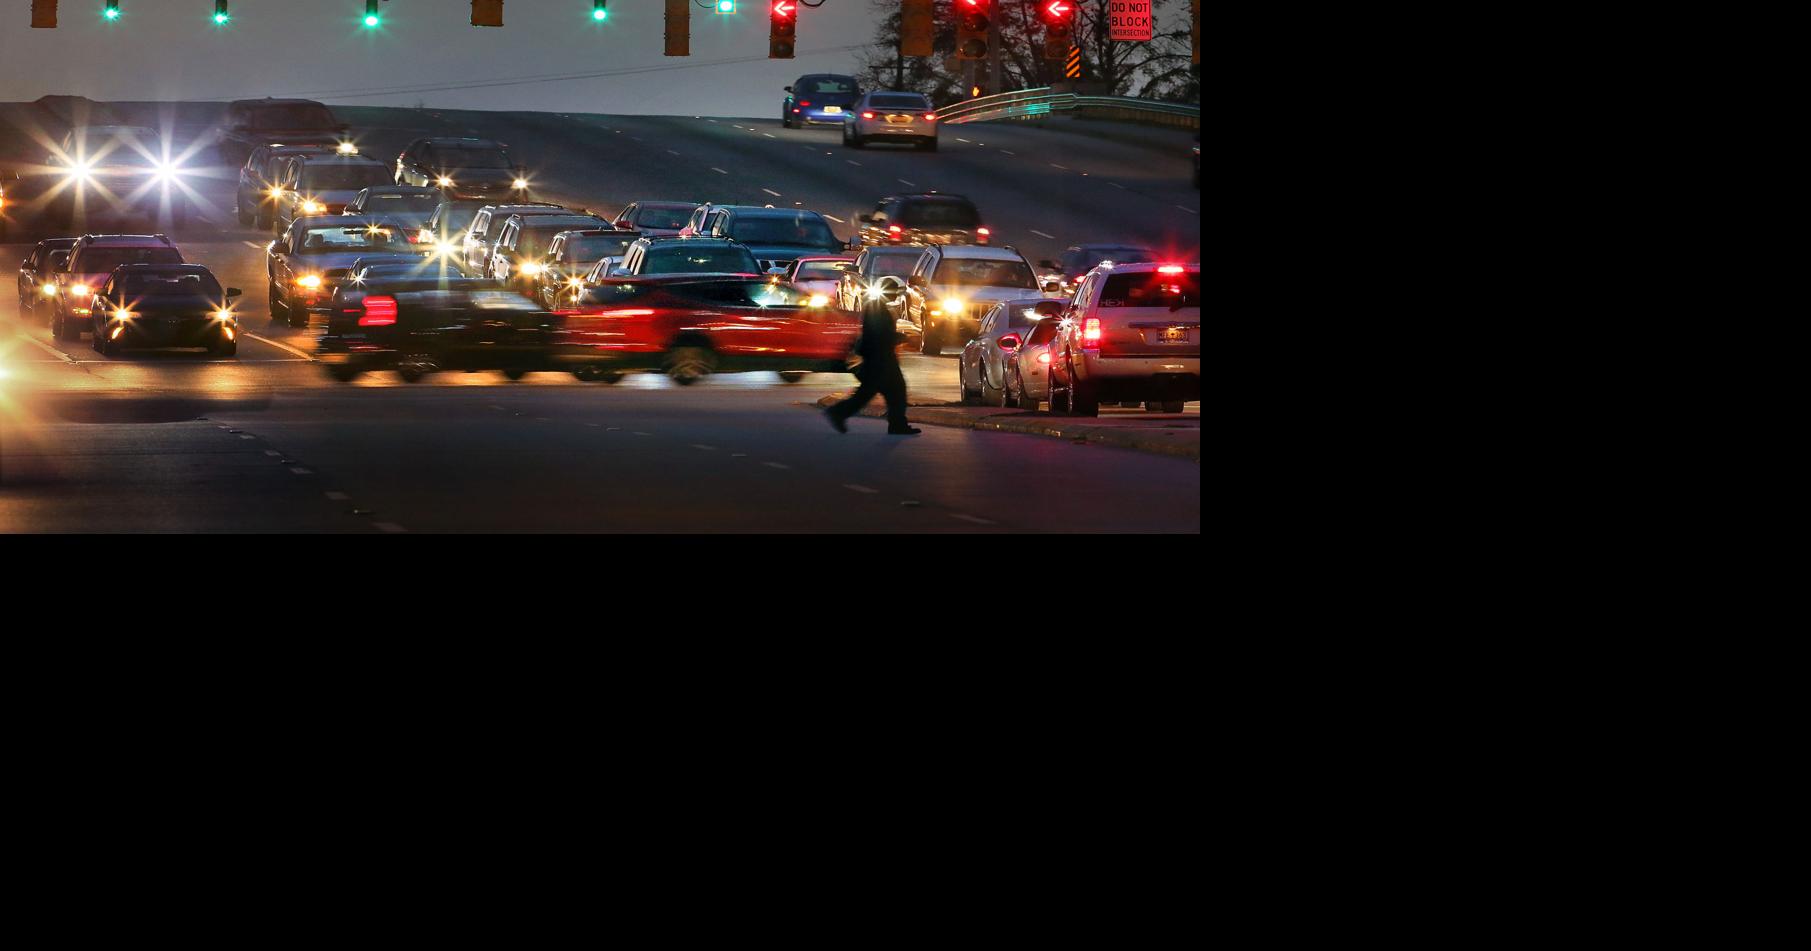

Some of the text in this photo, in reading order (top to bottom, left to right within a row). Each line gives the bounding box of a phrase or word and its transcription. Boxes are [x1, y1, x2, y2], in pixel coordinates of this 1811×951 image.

[1112, 3, 1148, 12] DO NOT
[1112, 16, 1148, 26] BLOCK
